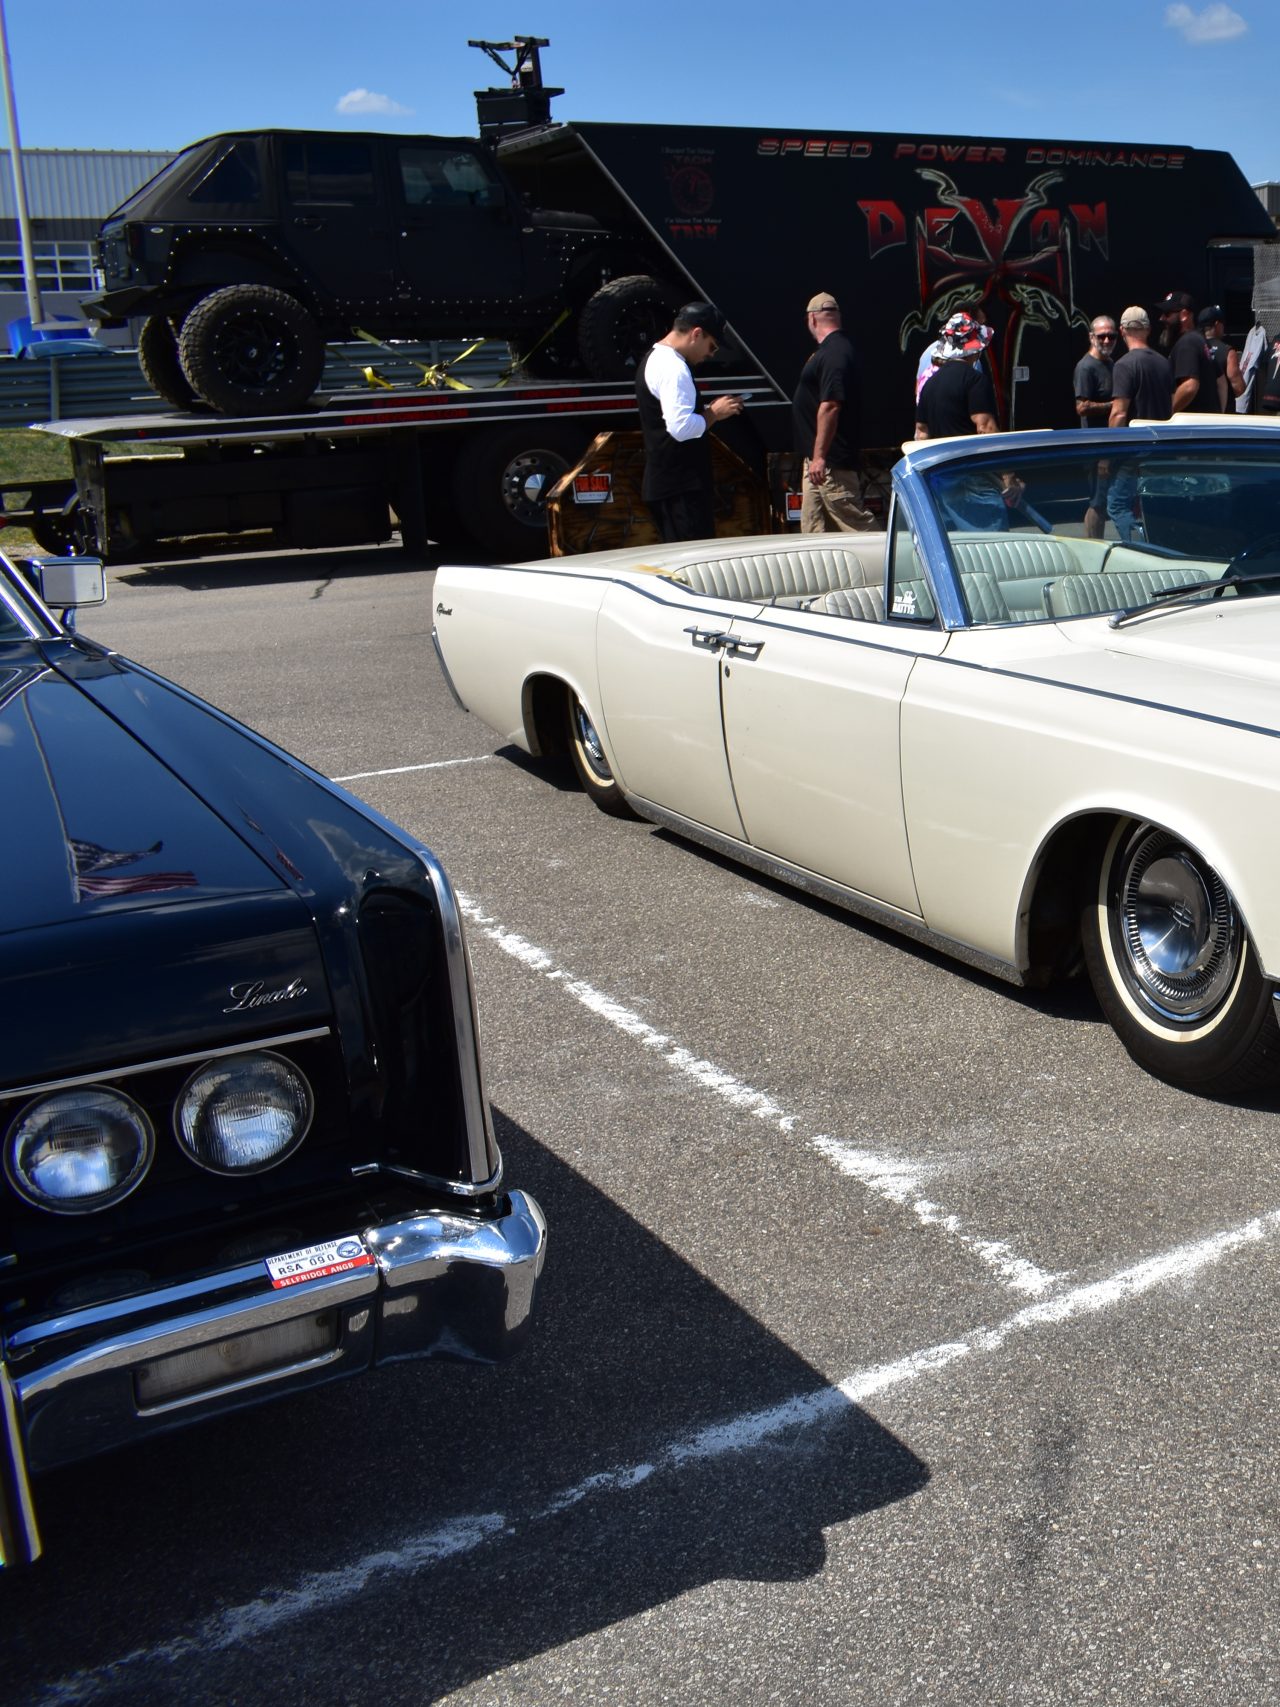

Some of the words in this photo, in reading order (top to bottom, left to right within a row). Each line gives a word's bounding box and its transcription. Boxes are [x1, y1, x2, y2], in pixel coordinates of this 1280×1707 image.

[757, 138, 873, 158] SPEED
[893, 143, 1007, 163] POWER
[1025, 147, 1186, 169] DOMINANCE
[857, 199, 1109, 262] DEVON
[222, 977, 307, 1013] Lincoln
[268, 1250, 303, 1264] DEPARTMENT
[315, 1242, 338, 1253] DEFENSE
[278, 1263, 303, 1275] RSA
[309, 1253, 335, 1266] 090
[280, 1268, 328, 1287] SELFRIDGE
[330, 1262, 354, 1273] ANGB
